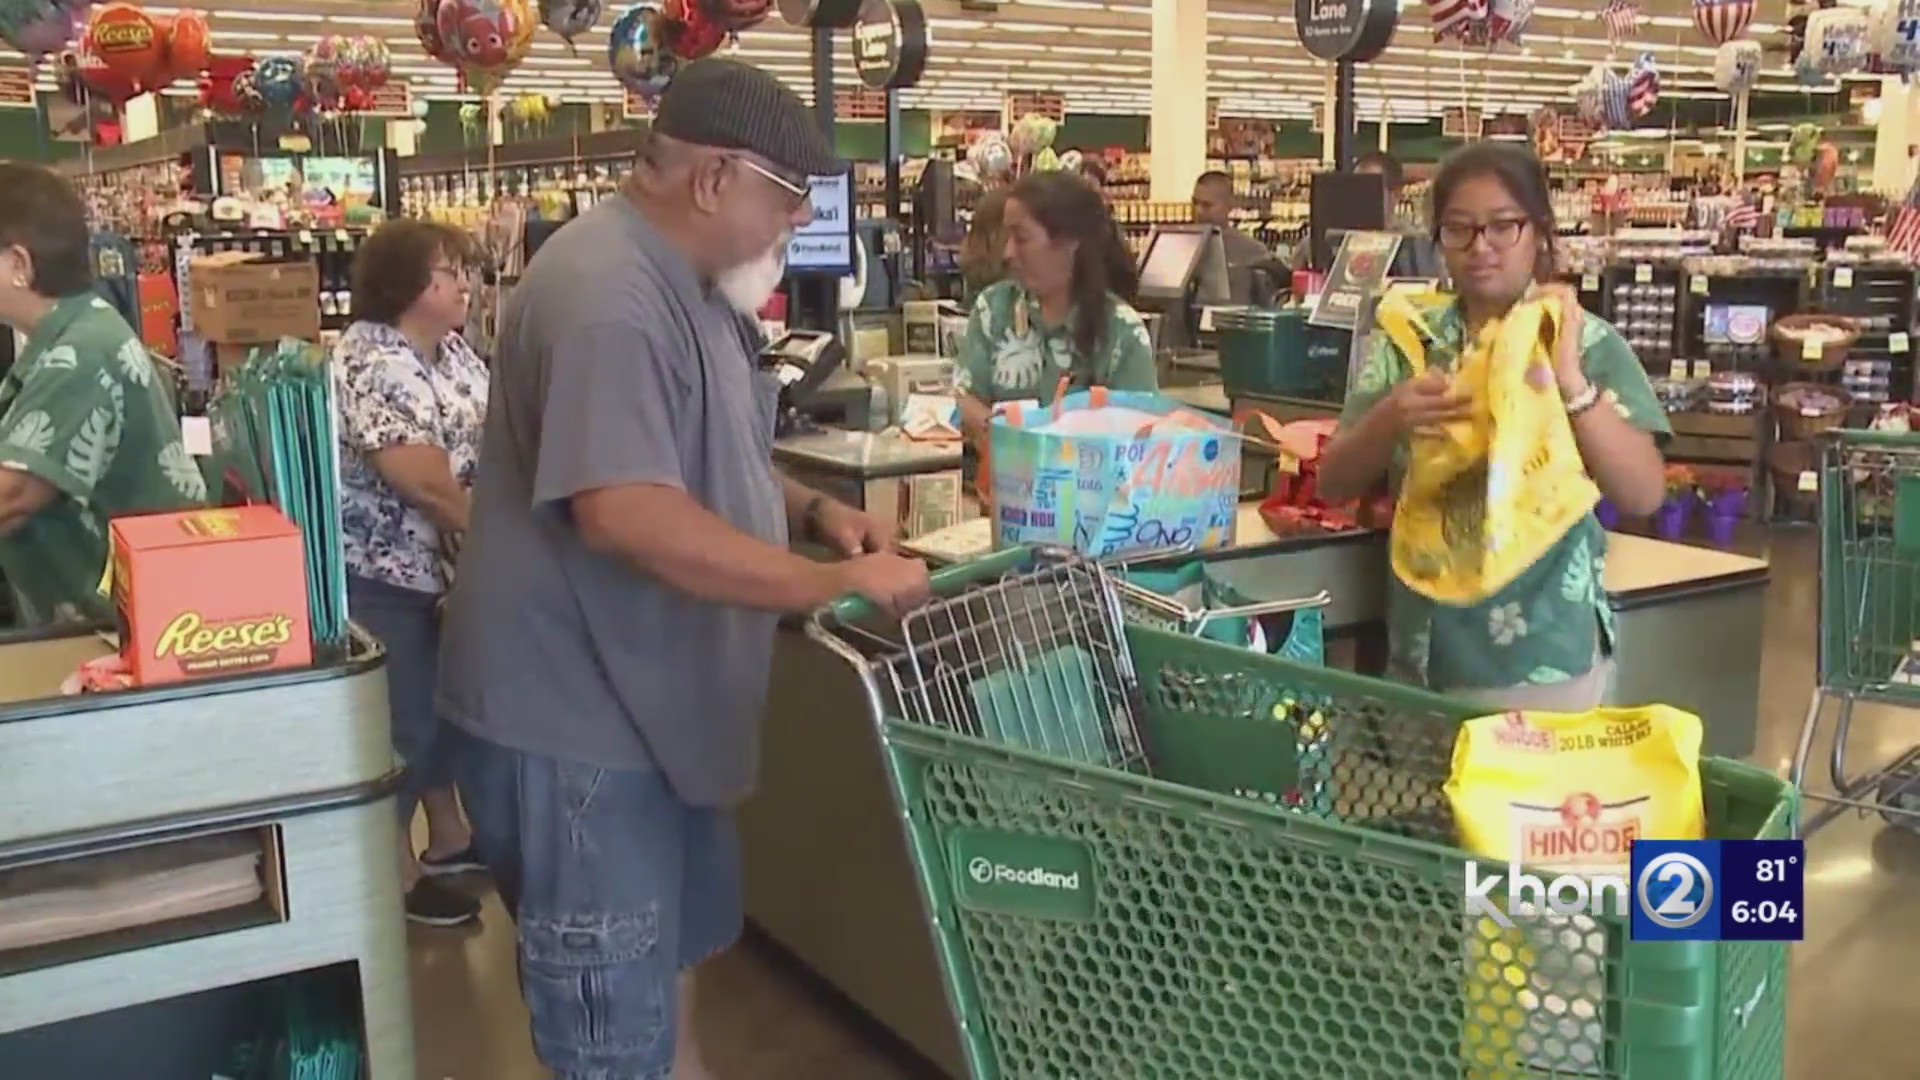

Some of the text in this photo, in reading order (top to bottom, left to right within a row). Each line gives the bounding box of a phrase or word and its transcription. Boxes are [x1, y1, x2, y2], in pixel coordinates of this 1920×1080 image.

[1310, 0, 1347, 20] Lane
[154, 612, 293, 658] Reese's
[1559, 734, 1595, 751] 20 LB
[1530, 826, 1635, 856] HINODE
[994, 863, 1080, 890] Foodland
